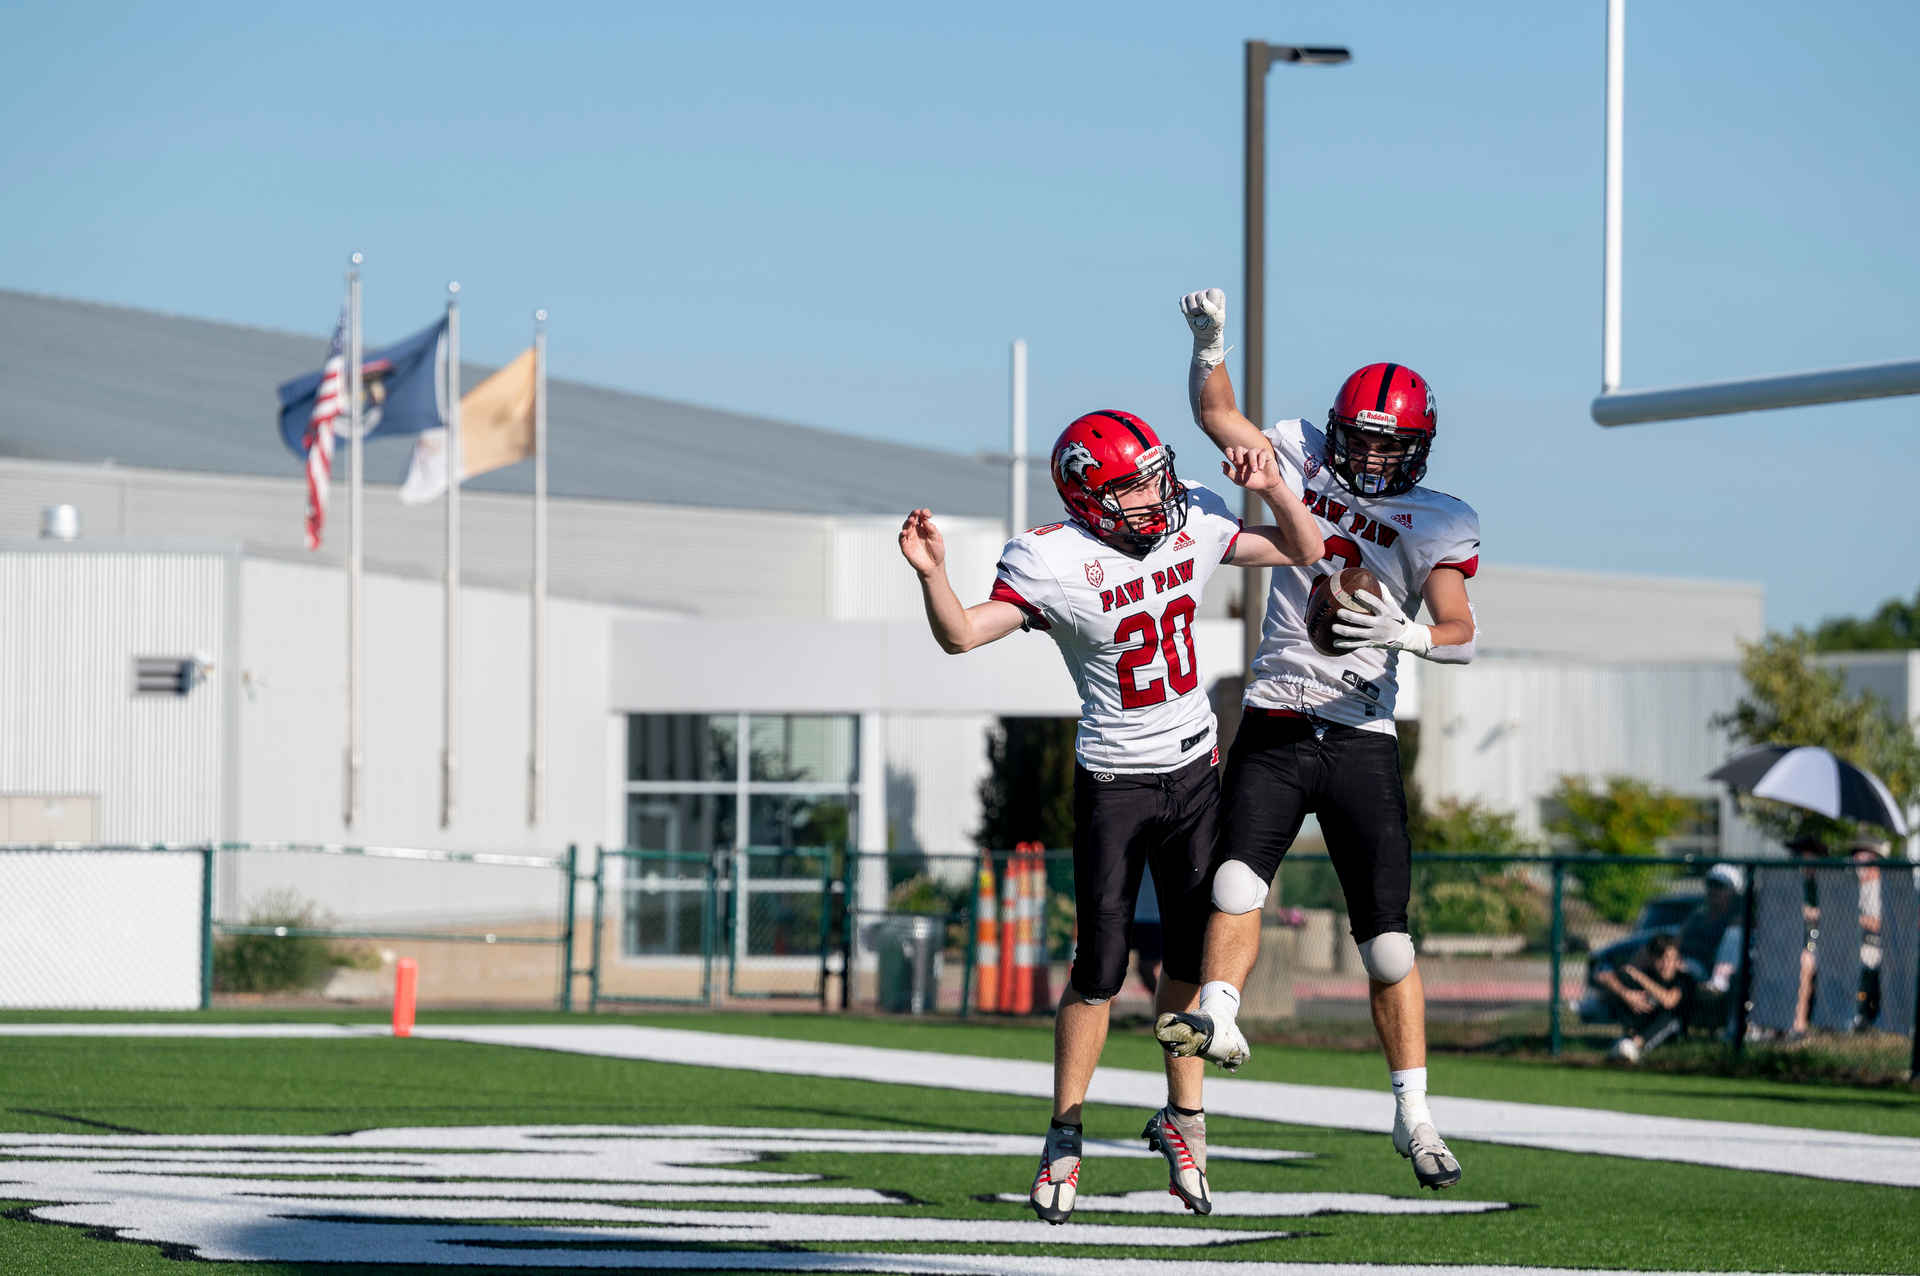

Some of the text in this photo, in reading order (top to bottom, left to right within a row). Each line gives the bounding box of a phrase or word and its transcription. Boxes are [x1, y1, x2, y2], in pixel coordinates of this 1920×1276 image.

[1366, 411, 1389, 422] Riddell
[1142, 448, 1158, 462] Riddell
[1302, 488, 1400, 549] PAW PAW
[1390, 514, 1413, 530] adidas
[1173, 539, 1196, 552] adidas
[1099, 557, 1195, 613] PAW PAW
[1114, 594, 1198, 709] 20
